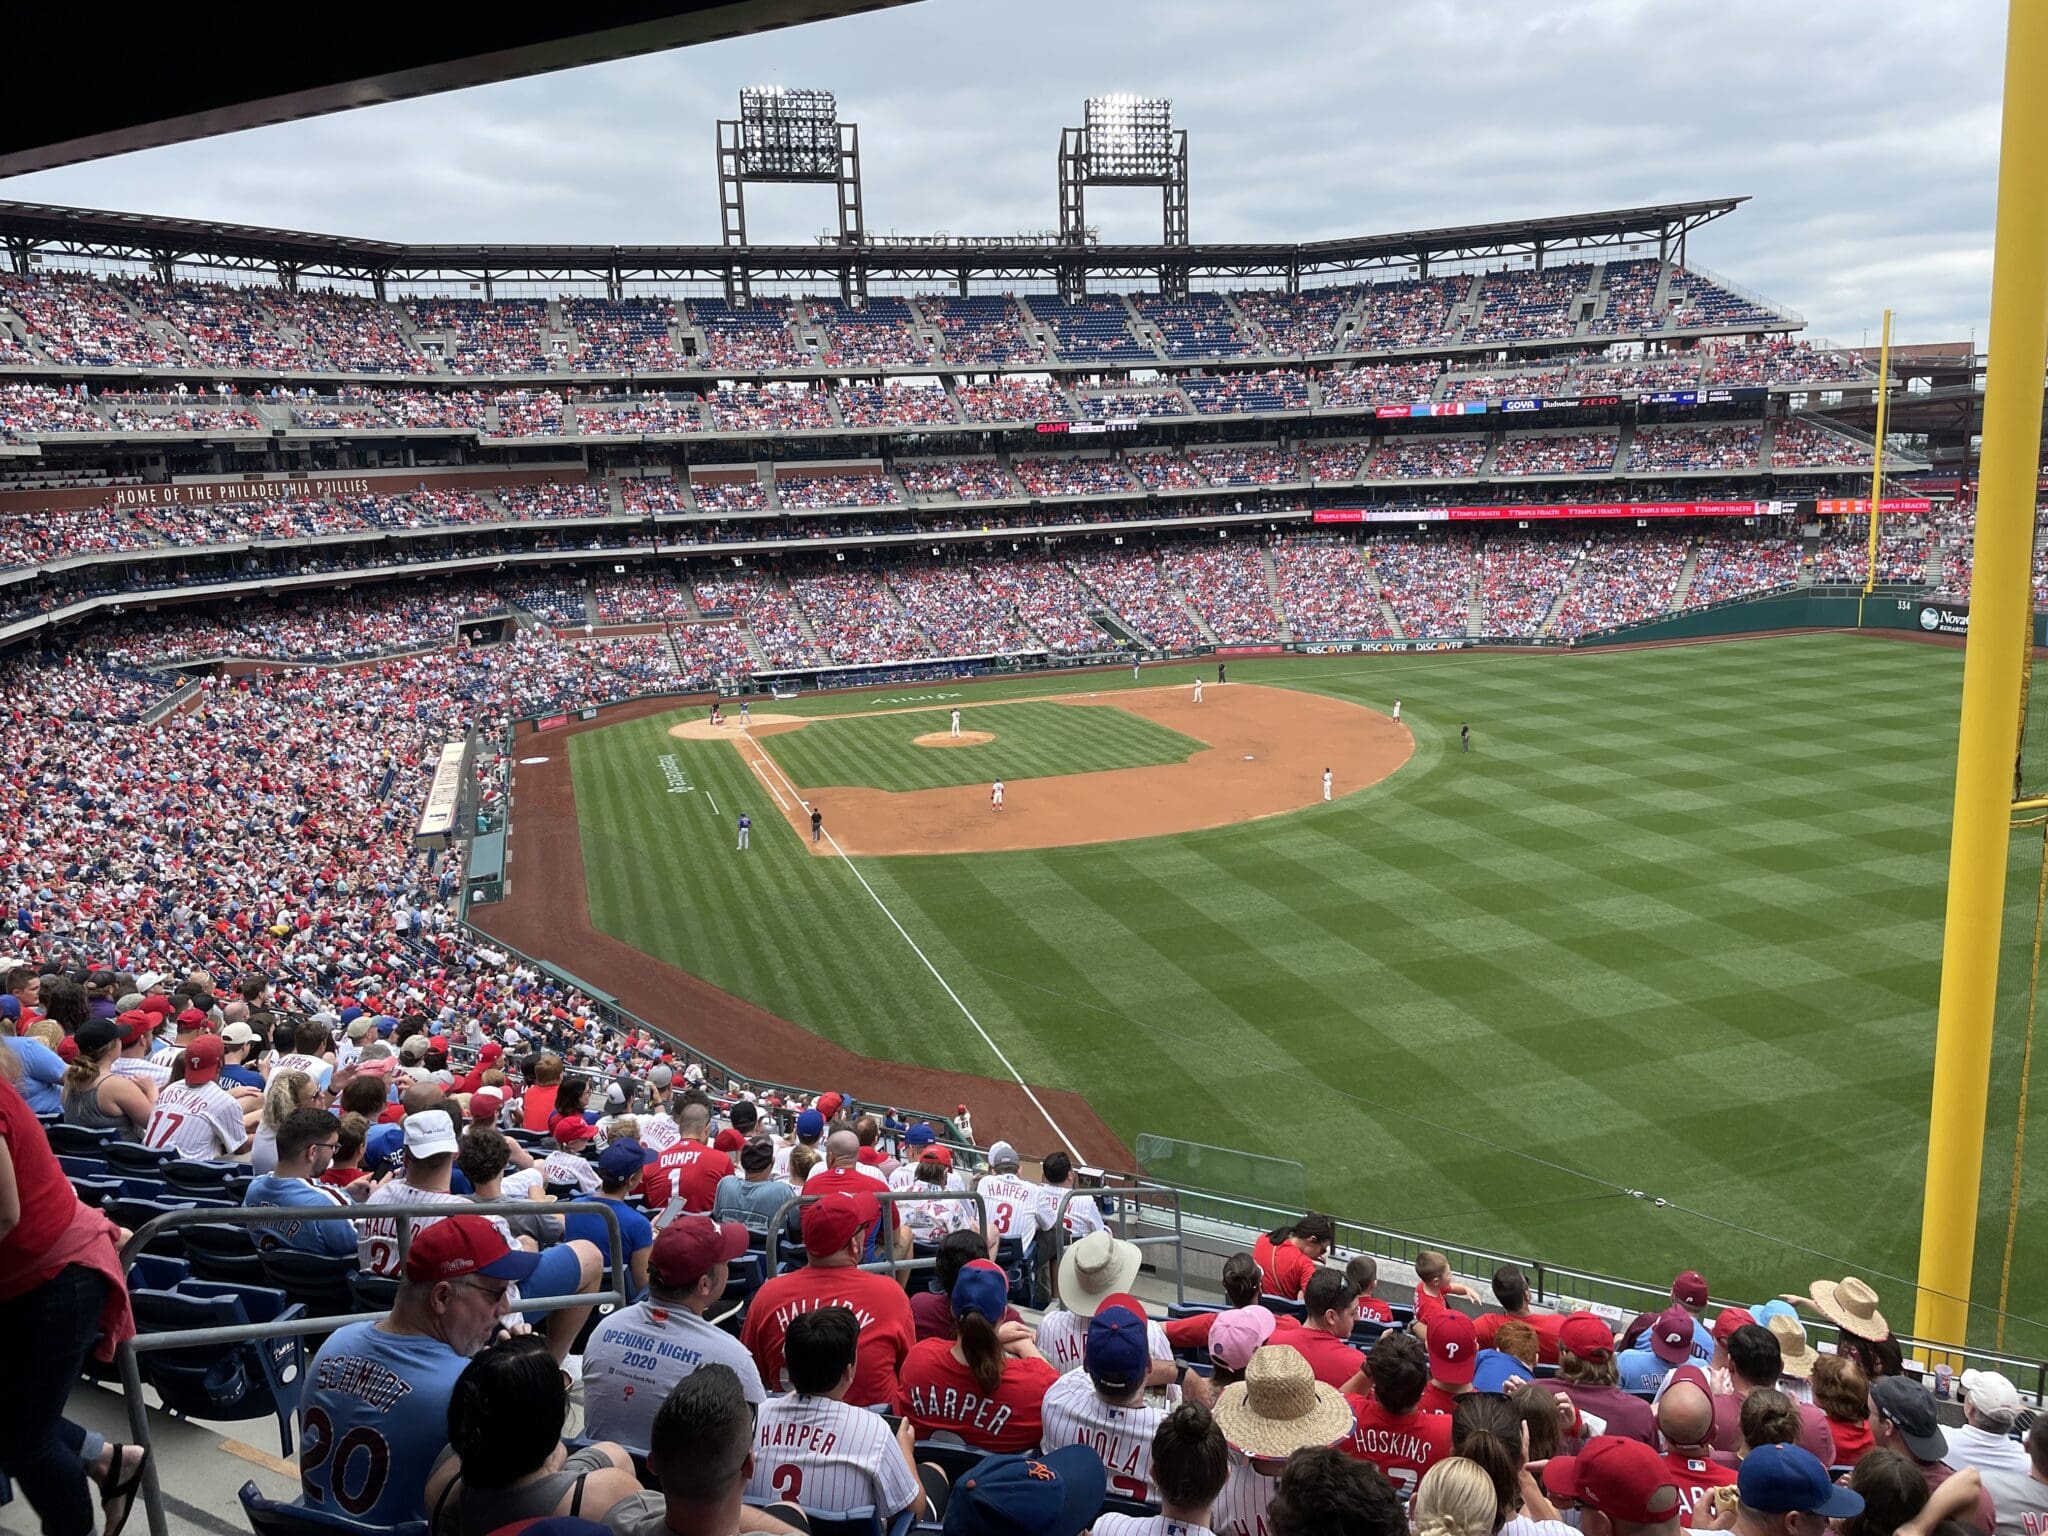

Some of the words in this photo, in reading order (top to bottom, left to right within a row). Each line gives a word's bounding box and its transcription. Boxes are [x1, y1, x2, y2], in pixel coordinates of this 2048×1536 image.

[1506, 400, 1535, 410] GOYA
[1542, 400, 1580, 408] Budweiser
[1582, 397, 1618, 406] ZERO
[1036, 423, 1069, 433] GIANT
[117, 489, 157, 504] HOME
[163, 488, 181, 501] OF
[188, 486, 212, 500] THE
[1701, 505, 1724, 513] TEMPLE
[1726, 505, 1752, 513] HEALTH
[1939, 610, 1970, 625] Nova
[1307, 644, 1353, 654] DISCOVER
[1361, 643, 1408, 652] DISCOVER
[1416, 642, 1463, 651] DISCOVER
[156, 1090, 208, 1114] HOSKINS
[145, 1110, 184, 1149] 17
[660, 1151, 702, 1168] DUMPY
[988, 1183, 1028, 1201] HARPER
[994, 1203, 1013, 1233] 3
[602, 1329, 655, 1352] OPENING
[657, 1341, 702, 1366] NIGHT
[1445, 1342, 1460, 1359] P
[622, 1351, 657, 1371] 2020
[318, 1356, 412, 1413] SCHMIDT
[910, 1384, 1012, 1436] HARPER
[760, 1422, 837, 1456] HARPER
[1355, 1428, 1432, 1464] HOSKINS
[1077, 1427, 1142, 1476] NOLA
[300, 1405, 391, 1517] 20
